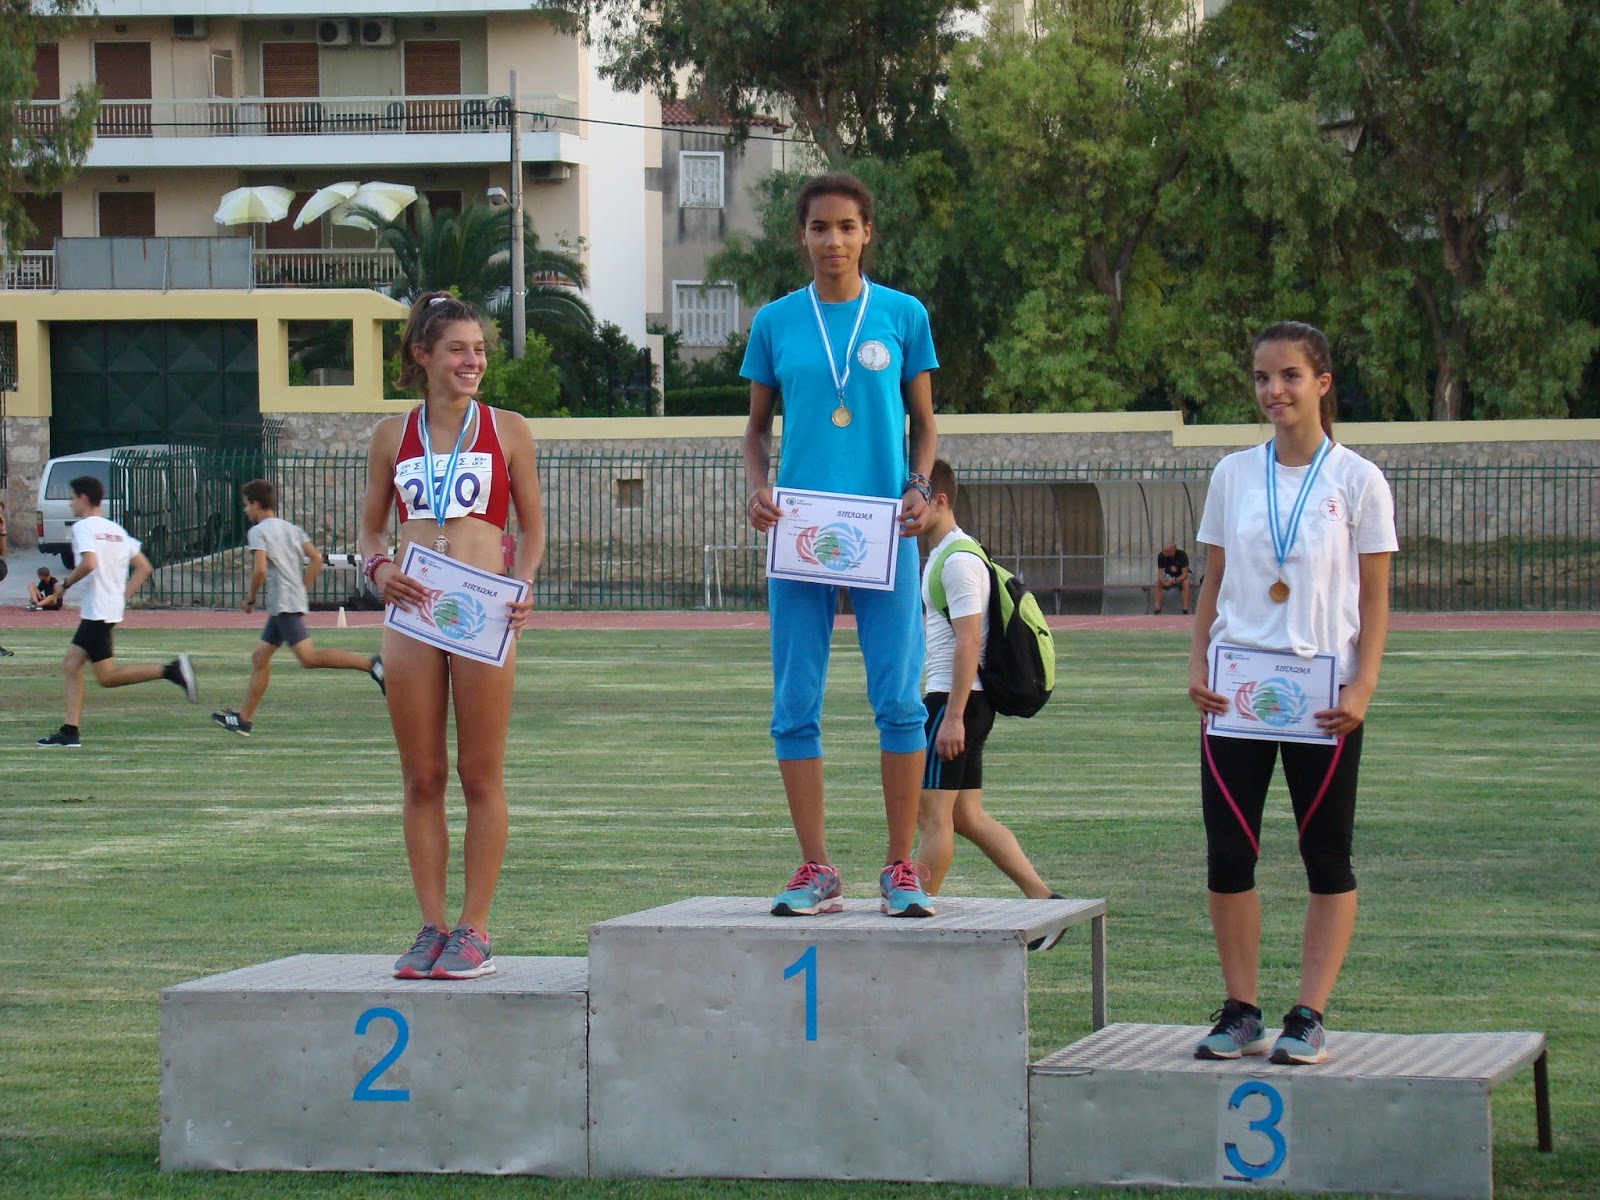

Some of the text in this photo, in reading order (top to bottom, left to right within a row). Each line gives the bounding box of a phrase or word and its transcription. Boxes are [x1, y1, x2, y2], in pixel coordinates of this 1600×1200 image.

[783, 946, 817, 1041] 1
[353, 1007, 410, 1101] 2
[1224, 1081, 1286, 1179] 3
